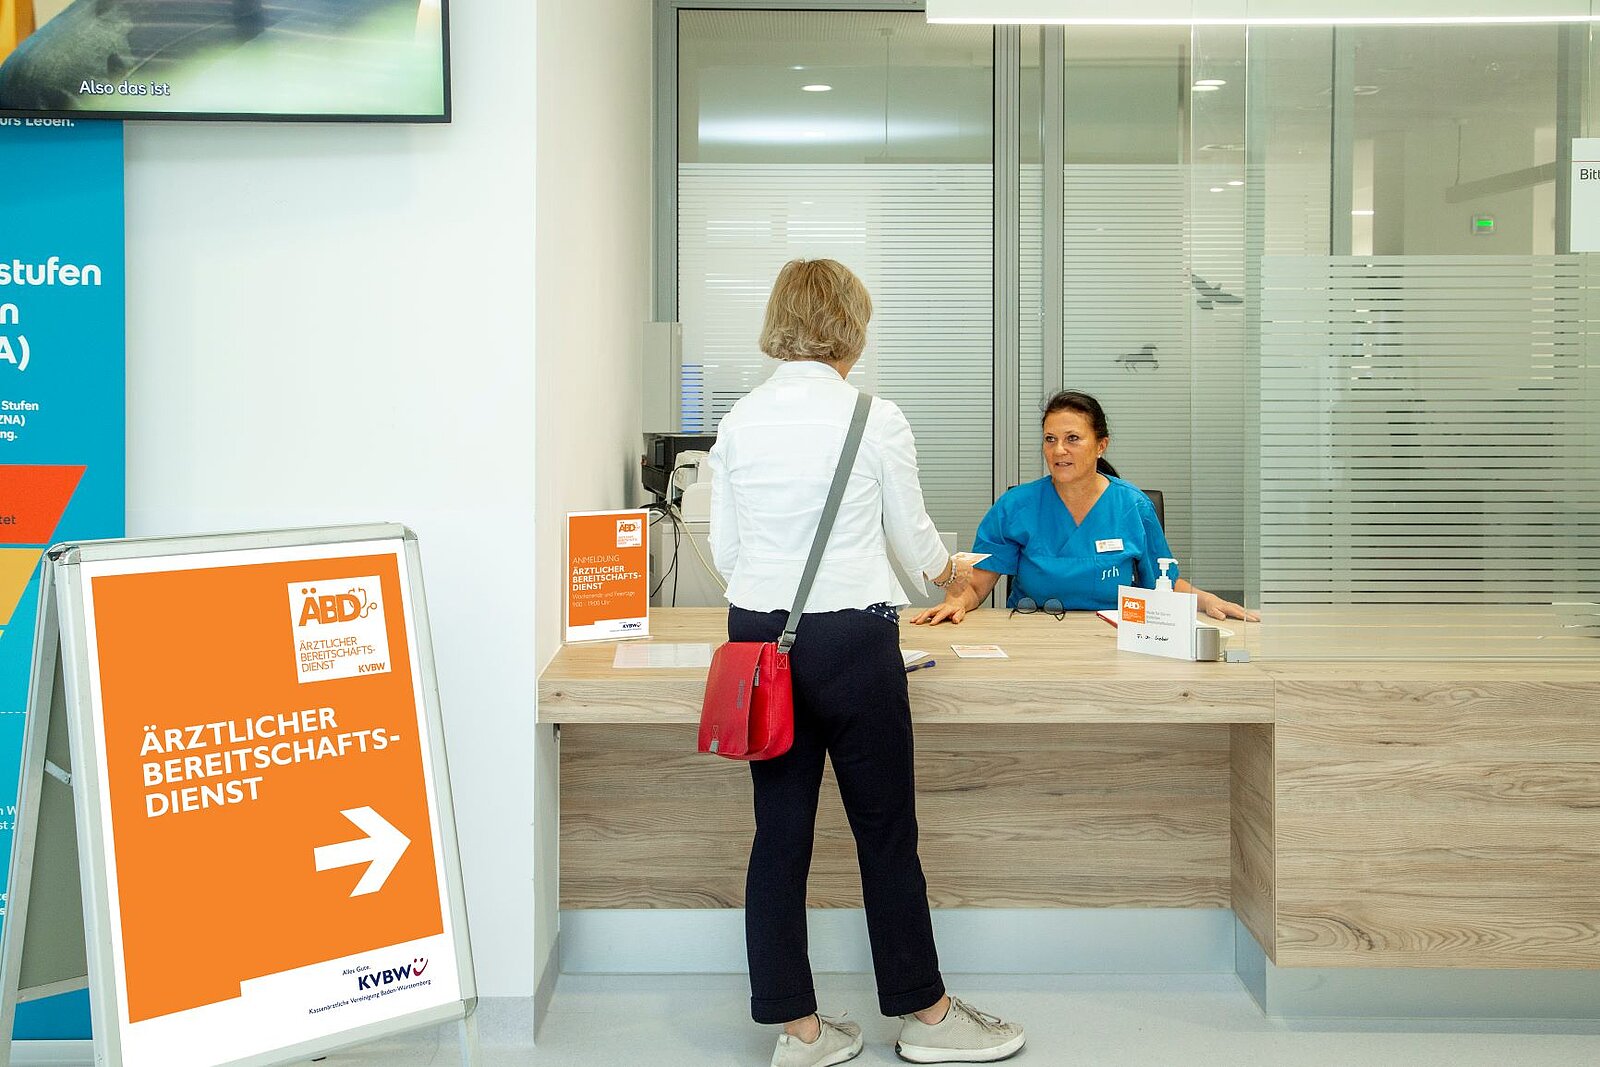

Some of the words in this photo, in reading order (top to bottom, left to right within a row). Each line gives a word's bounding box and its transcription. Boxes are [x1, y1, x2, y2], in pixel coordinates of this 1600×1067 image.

[80, 80, 114, 94] Also
[118, 80, 147, 95] das
[151, 81, 170, 95] ist
[1, 400, 39, 411] Stufen
[572, 554, 620, 564] ANMELDUNG
[572, 565, 625, 576] ÄRZTLICHER
[572, 572, 642, 584] BEREITSCHAFTS-
[572, 582, 603, 592] DIENST
[299, 587, 361, 627] ÄBD
[299, 636, 358, 651] ÄRZTLICHER
[300, 645, 376, 662] BEREITSCHAFTS-
[301, 659, 335, 673] DIENST
[358, 662, 385, 673] KVBW
[140, 707, 338, 756] ÄRZTLICHER
[142, 728, 400, 787] BEREITSCHAFTS-
[145, 776, 263, 818] DIENST
[342, 967, 355, 976] Alles
[355, 965, 371, 973] Gute.
[358, 964, 412, 991] KVBW
[350, 991, 380, 1004] Vereinigung
[380, 979, 432, 997] Baden-Württemberg
